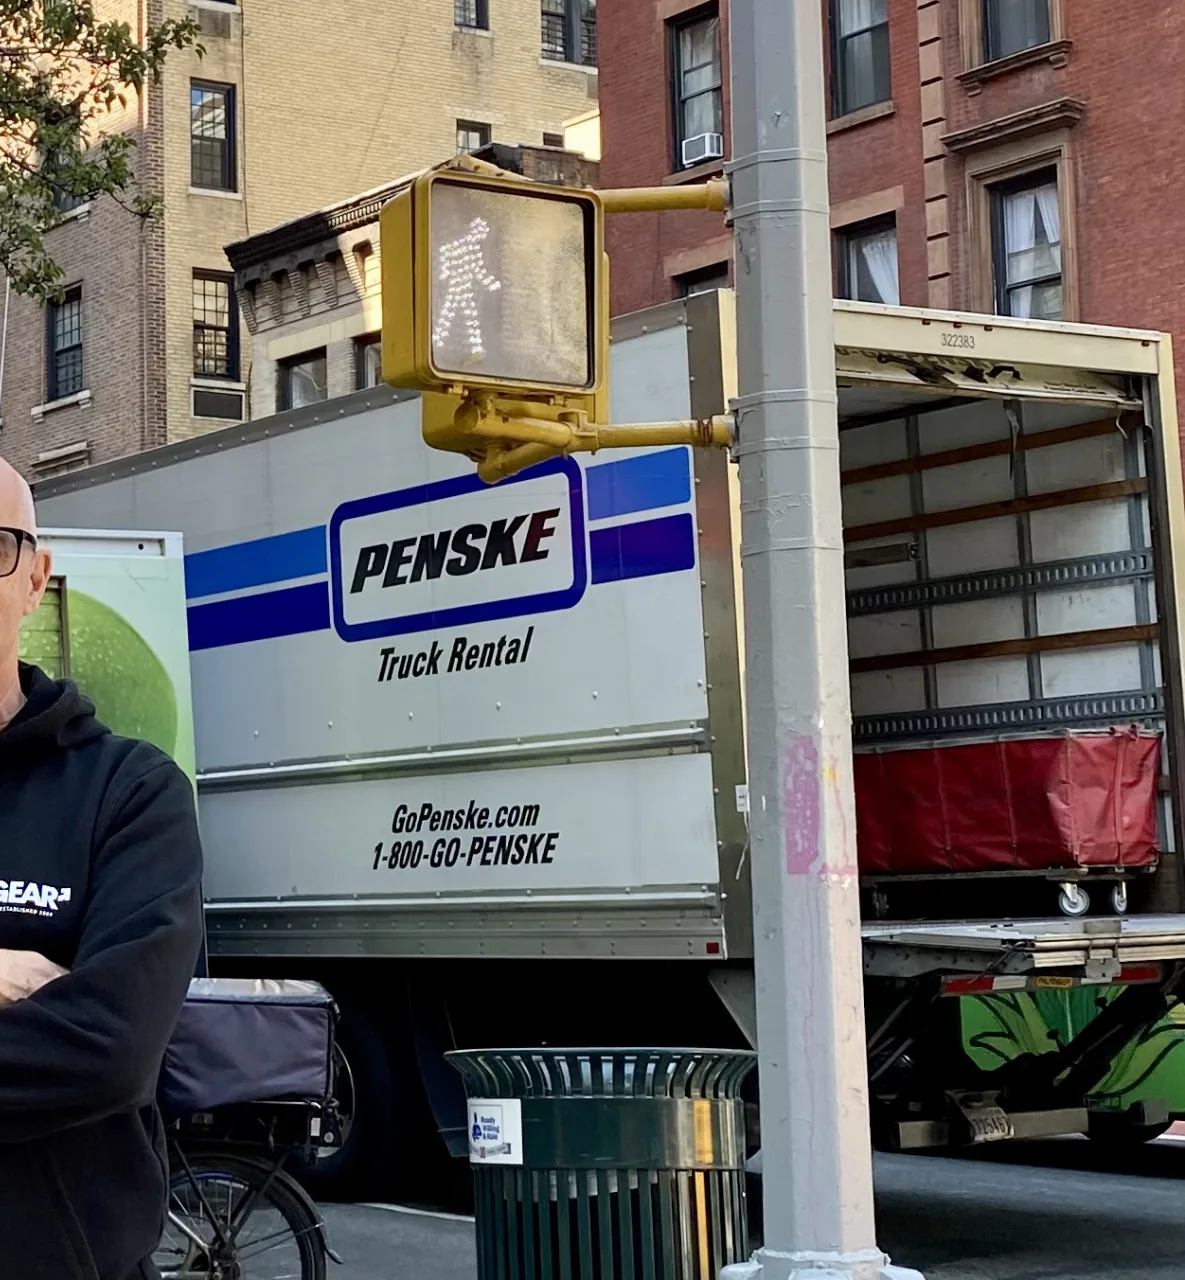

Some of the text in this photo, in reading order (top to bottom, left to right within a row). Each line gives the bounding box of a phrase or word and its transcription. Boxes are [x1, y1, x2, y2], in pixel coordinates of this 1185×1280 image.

[941, 333, 976, 349] 322383
[350, 508, 561, 594] PENSKE
[377, 626, 535, 683] Truck Rental
[391, 800, 541, 834] GoPenske.com
[371, 833, 560, 870] 1-800-GO-PENSKE
